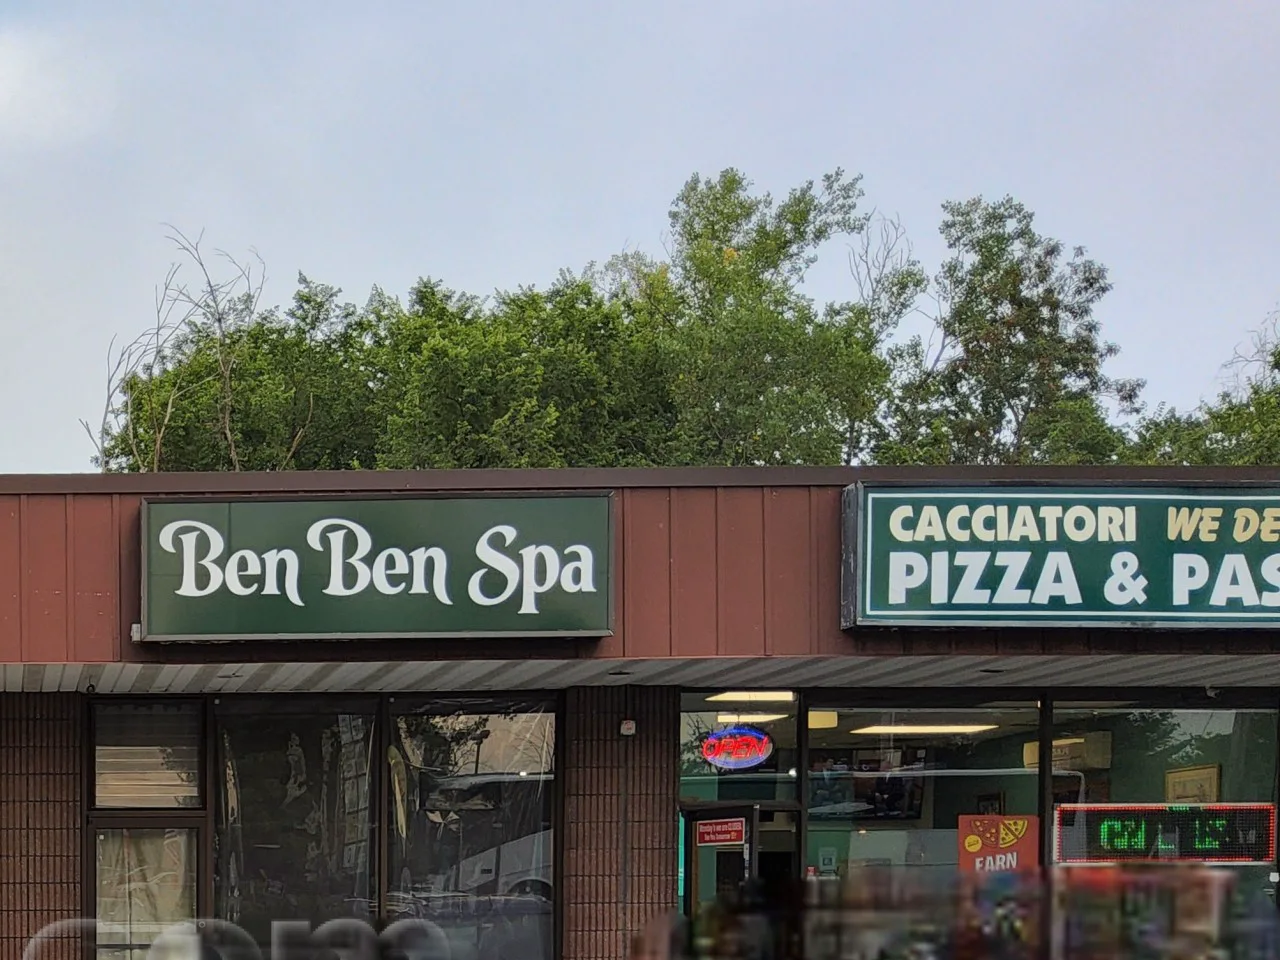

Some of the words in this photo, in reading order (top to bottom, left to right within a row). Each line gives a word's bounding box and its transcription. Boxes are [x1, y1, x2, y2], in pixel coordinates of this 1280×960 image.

[888, 504, 1137, 543] CACCIATORI
[1167, 506, 1223, 542] WE
[159, 519, 305, 607] Ben
[306, 518, 453, 605] Ben
[467, 524, 597, 614] Spa
[888, 550, 1083, 606] PIZZA
[1103, 551, 1149, 605] &
[702, 735, 769, 758] OPEN
